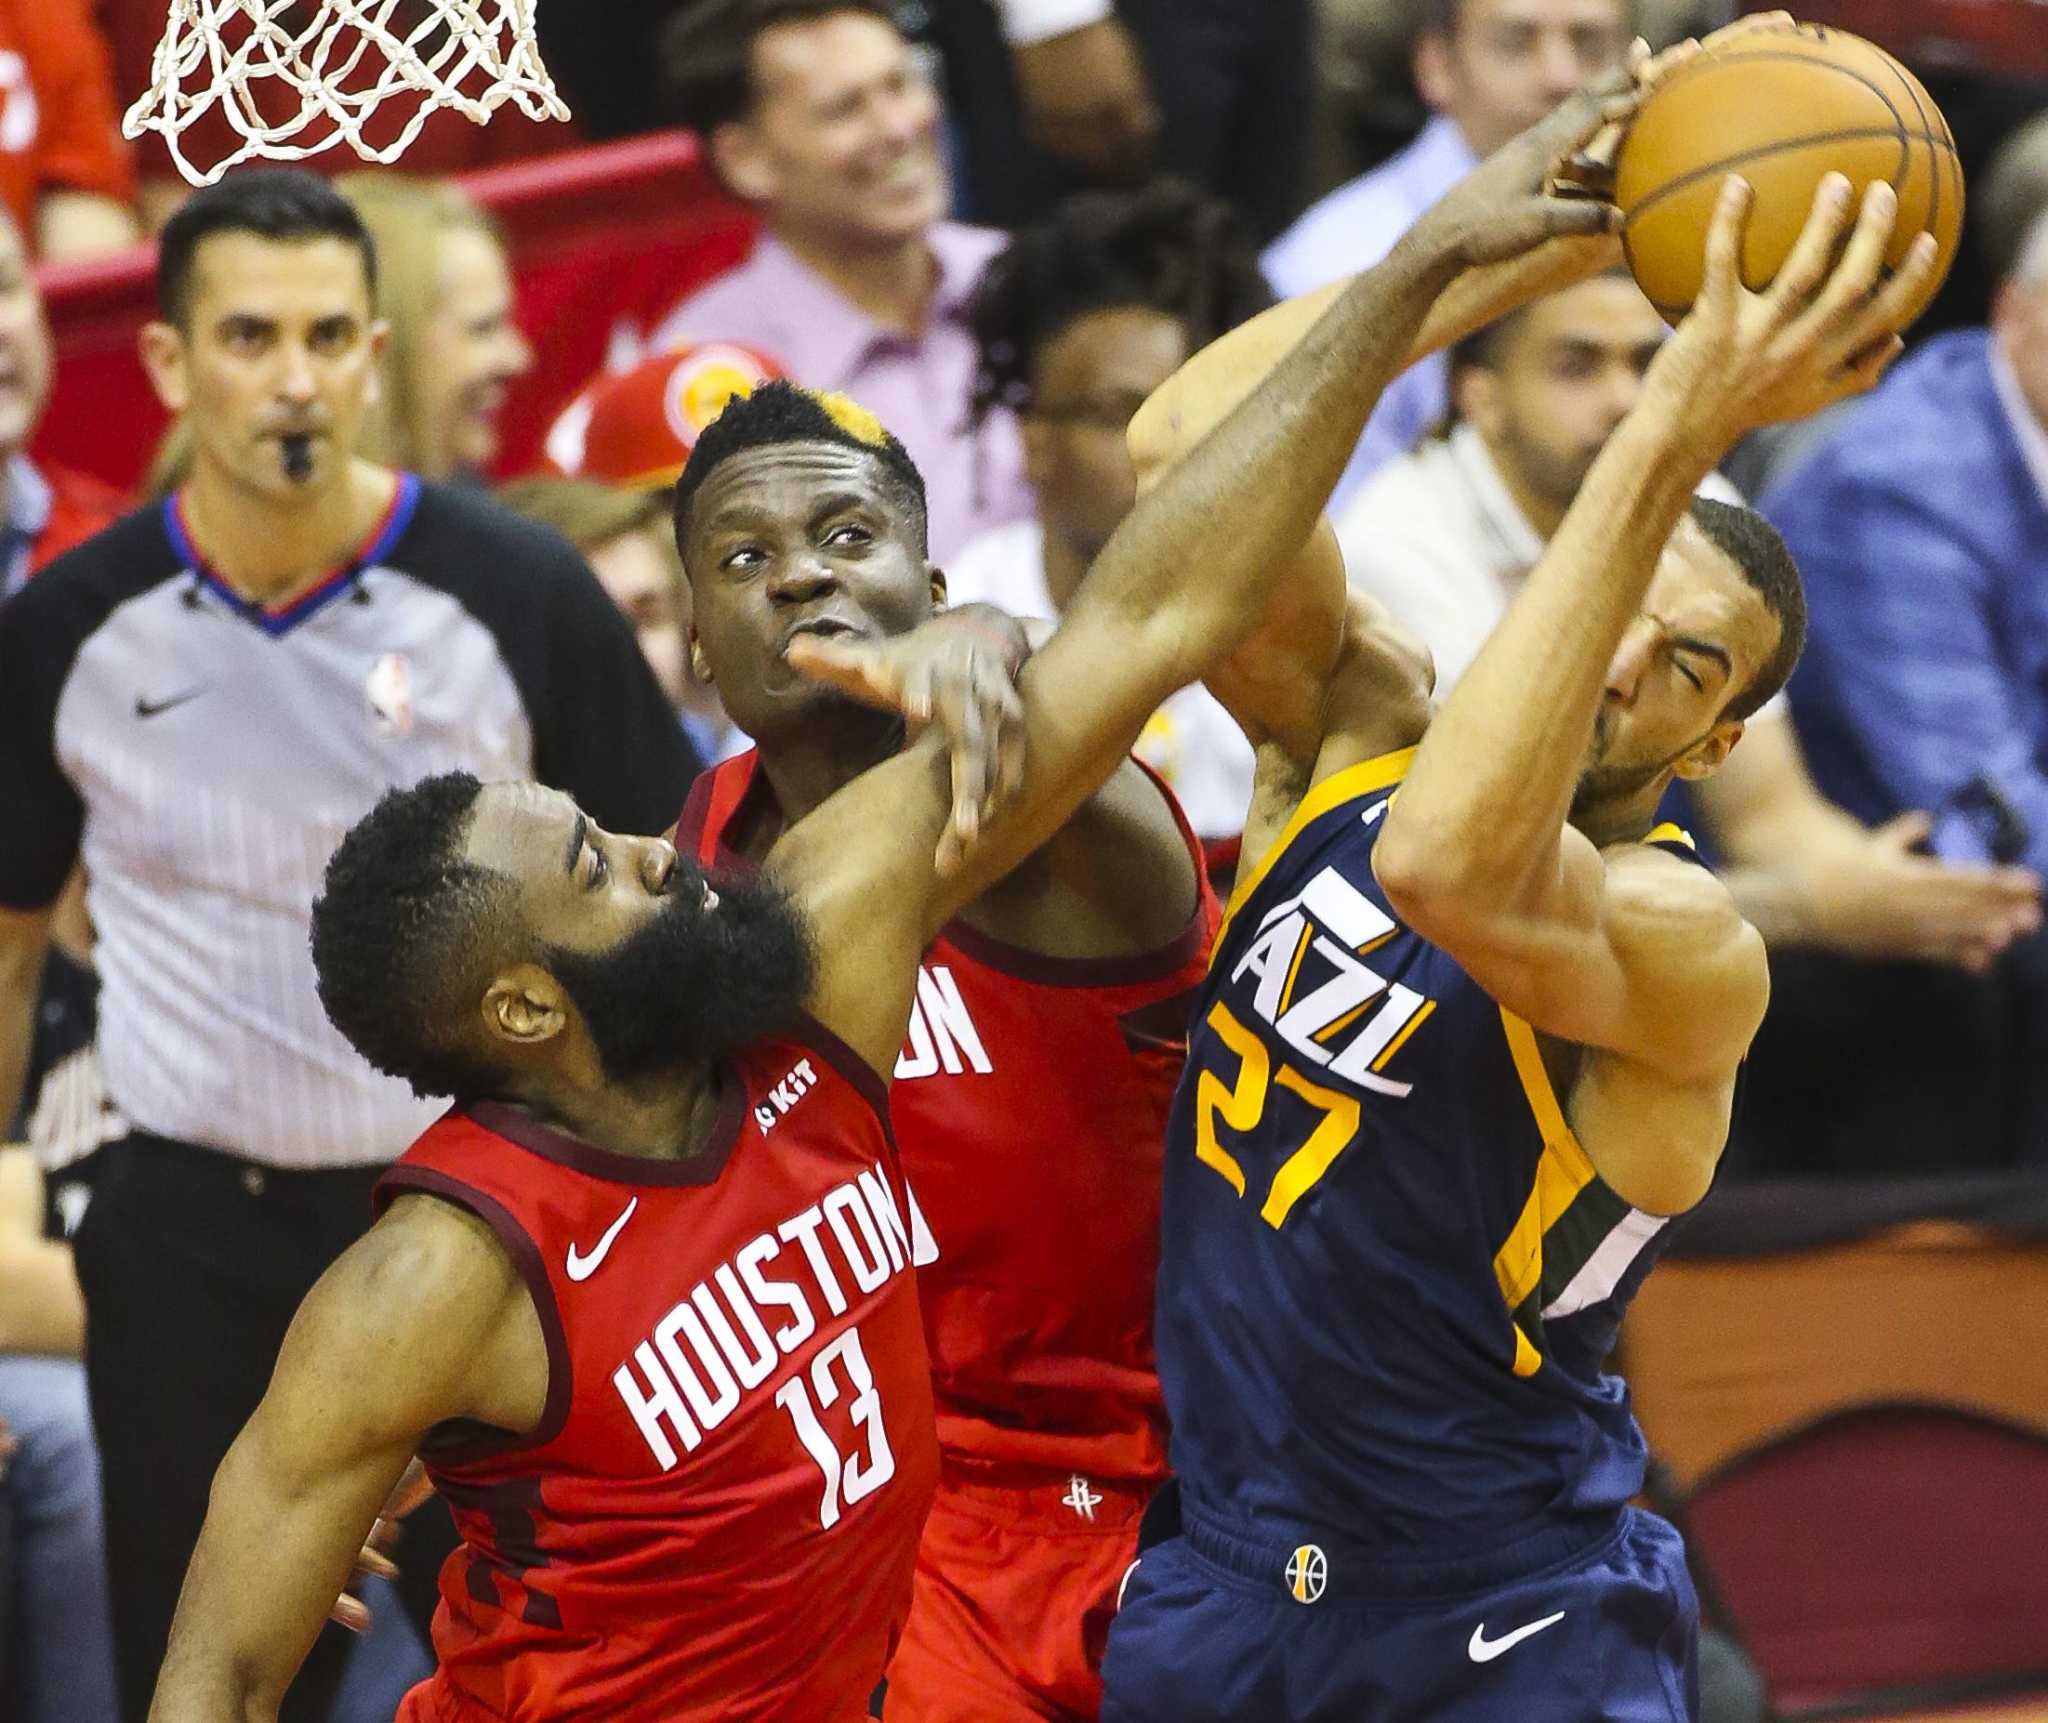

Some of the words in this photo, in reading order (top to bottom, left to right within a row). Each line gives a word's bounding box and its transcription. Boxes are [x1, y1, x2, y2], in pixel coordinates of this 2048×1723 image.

[1196, 1000, 1361, 1230] 27
[613, 1160, 912, 1472] HOUSTON
[776, 1327, 896, 1530] 13
